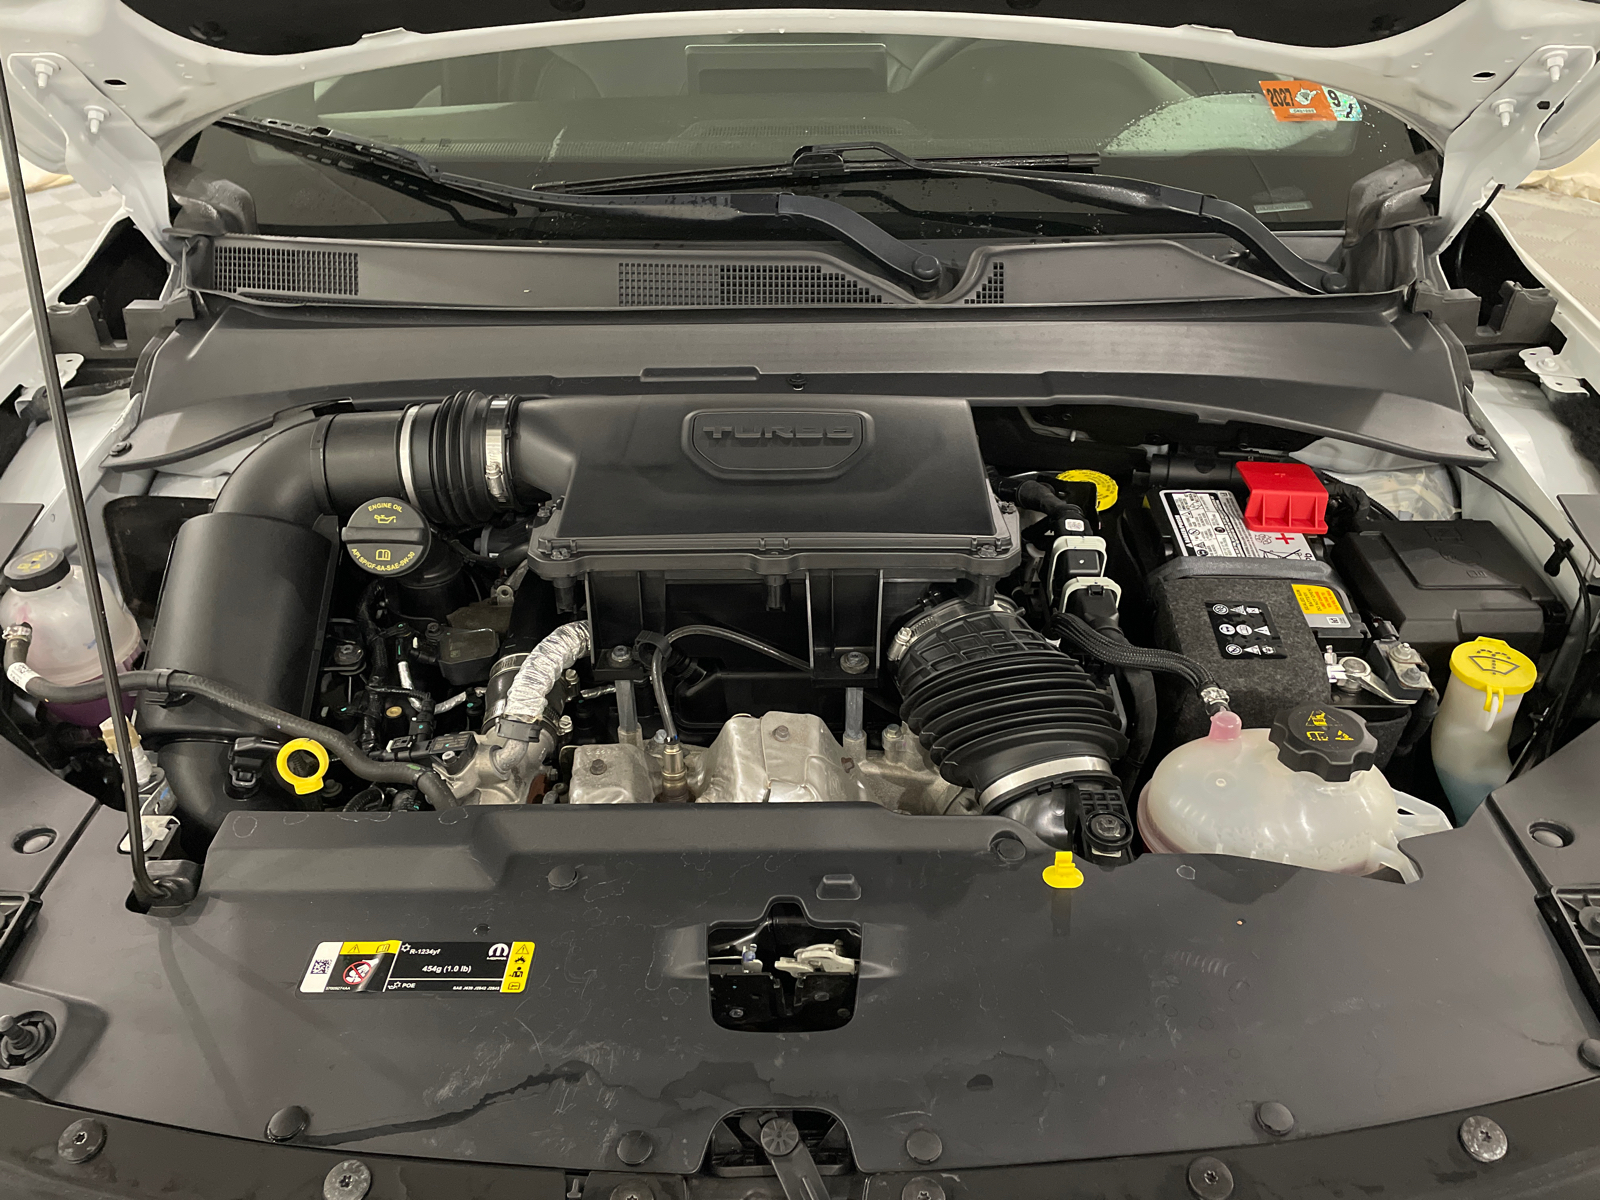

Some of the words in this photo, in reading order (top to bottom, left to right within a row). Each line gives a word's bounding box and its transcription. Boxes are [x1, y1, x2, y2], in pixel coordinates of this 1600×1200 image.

[1266, 87, 1295, 107] 2027
[1327, 90, 1341, 107] 9
[702, 426, 854, 440] TURBO
[367, 502, 392, 512] ENGINE
[392, 504, 403, 513] OIL
[351, 548, 361, 559] API
[409, 948, 441, 956] R-1234yf
[421, 965, 442, 973] 454g
[443, 965, 459, 973] (1.0
[460, 965, 472, 973] lb)
